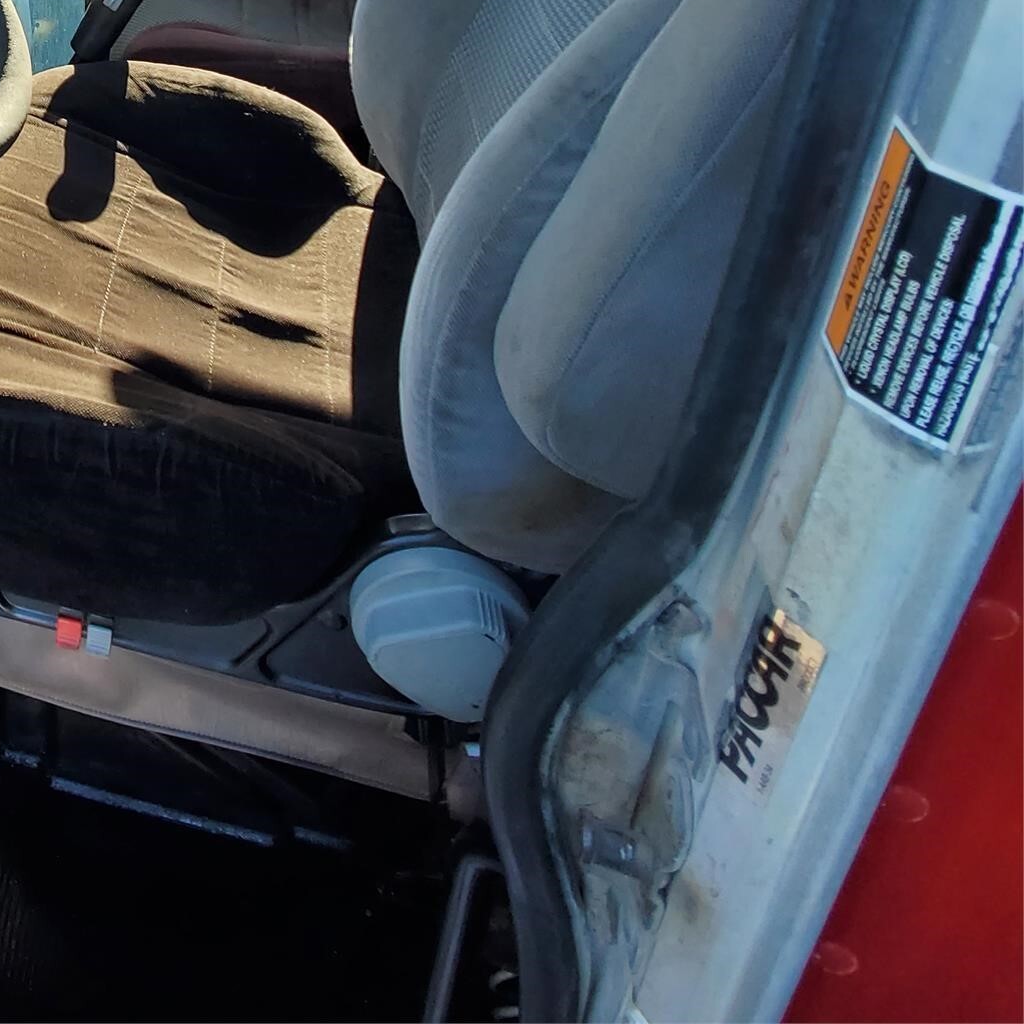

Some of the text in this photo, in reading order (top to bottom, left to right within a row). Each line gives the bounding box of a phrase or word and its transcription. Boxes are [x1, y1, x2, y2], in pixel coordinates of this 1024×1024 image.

[849, 180, 891, 288] WARNING
[857, 349, 875, 379] LIQUID
[867, 312, 889, 351] CRYSTAL
[883, 310, 909, 358] HEADLAMP
[901, 279, 921, 311] BULBS
[884, 371, 906, 409] REMOVE
[910, 299, 934, 337] BEFORE
[923, 261, 948, 301] VEHICLE
[909, 351, 934, 395] REMOVAL
[924, 338, 939, 354] OF
[916, 393, 939, 429] PLEASE
[719, 613, 802, 784] PACCAR
